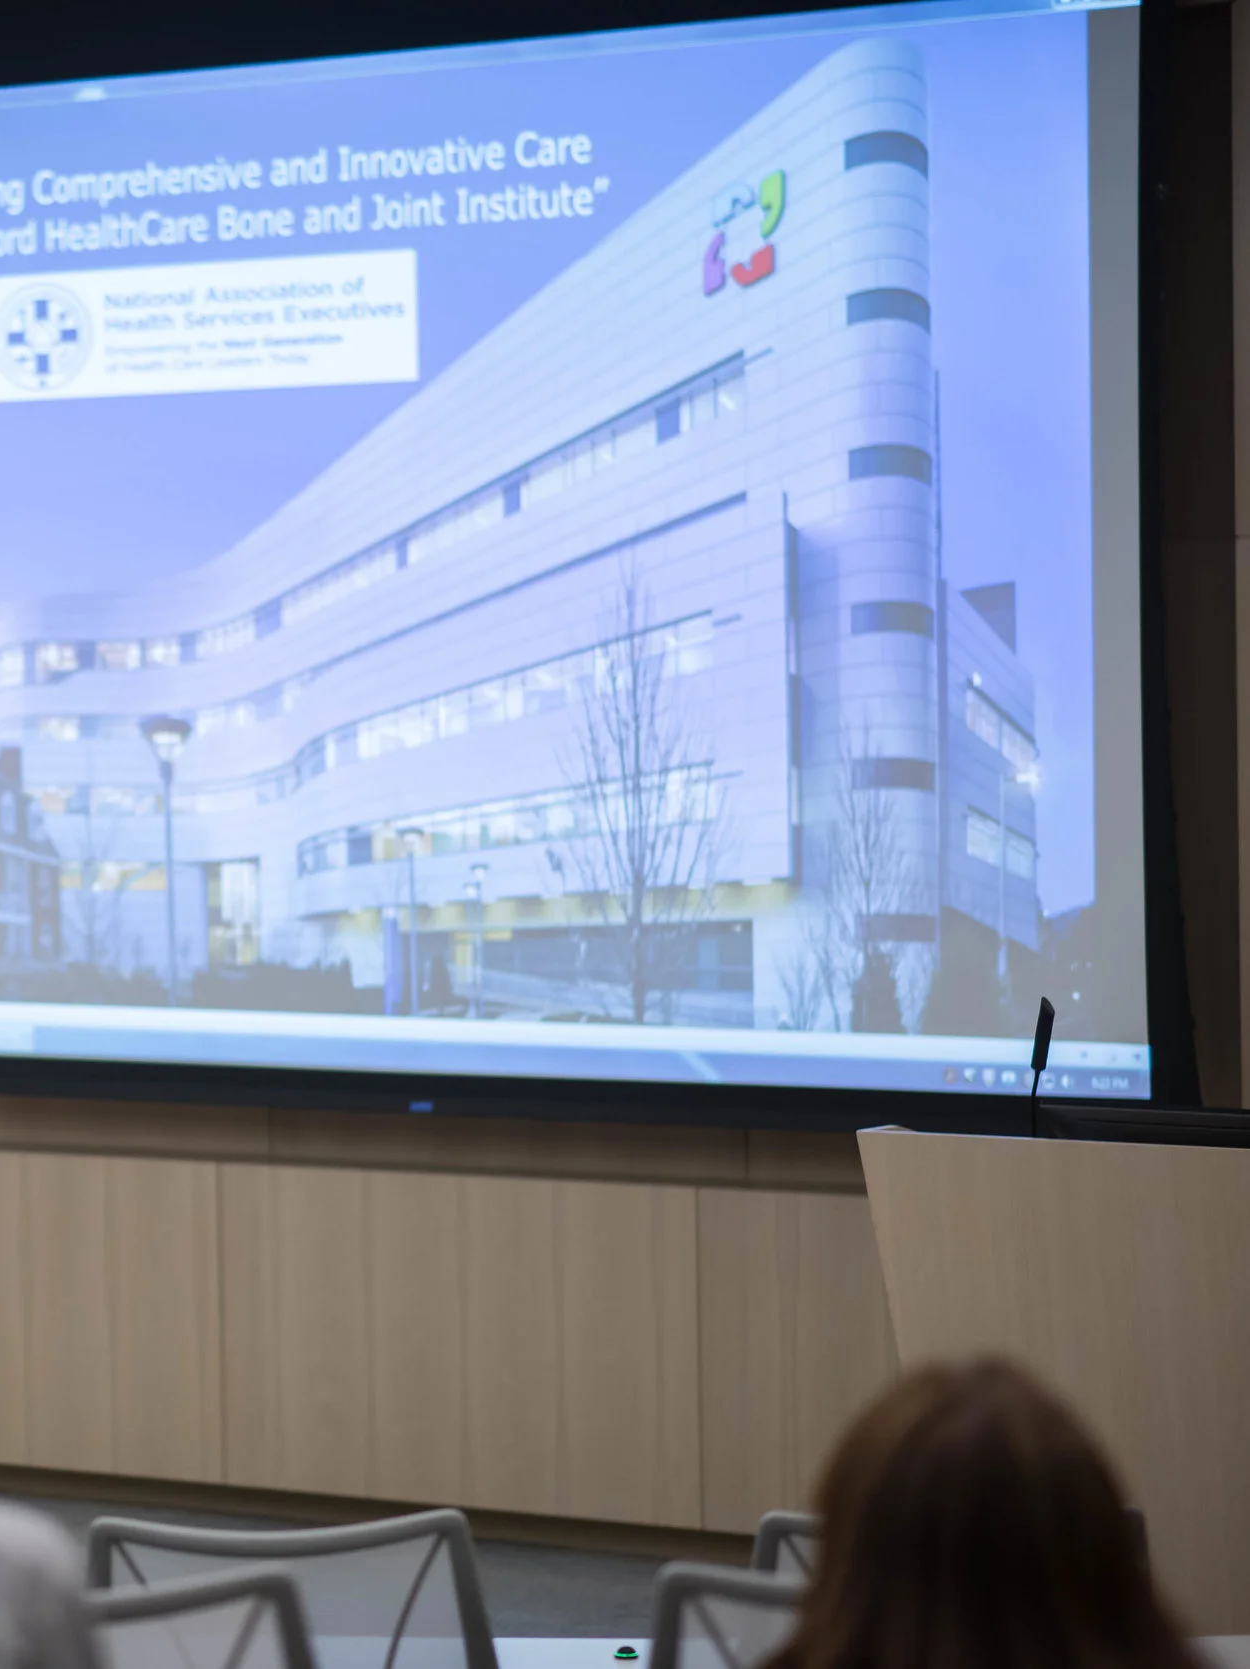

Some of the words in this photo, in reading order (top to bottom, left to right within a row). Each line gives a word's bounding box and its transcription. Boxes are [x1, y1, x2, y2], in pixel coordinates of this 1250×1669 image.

[32, 155, 262, 208] Comprehensive
[269, 147, 329, 187] and
[338, 136, 506, 182] Innovative
[514, 129, 592, 168] Care
[45, 209, 209, 253] HealthCare
[217, 204, 295, 240] Bone
[302, 194, 361, 235] and
[370, 191, 446, 231] Joint
[103, 287, 194, 309] National
[204, 282, 333, 302] Association
[341, 276, 365, 295] of
[104, 312, 175, 332] Health
[184, 309, 274, 328] Services
[284, 300, 405, 322] Executives
